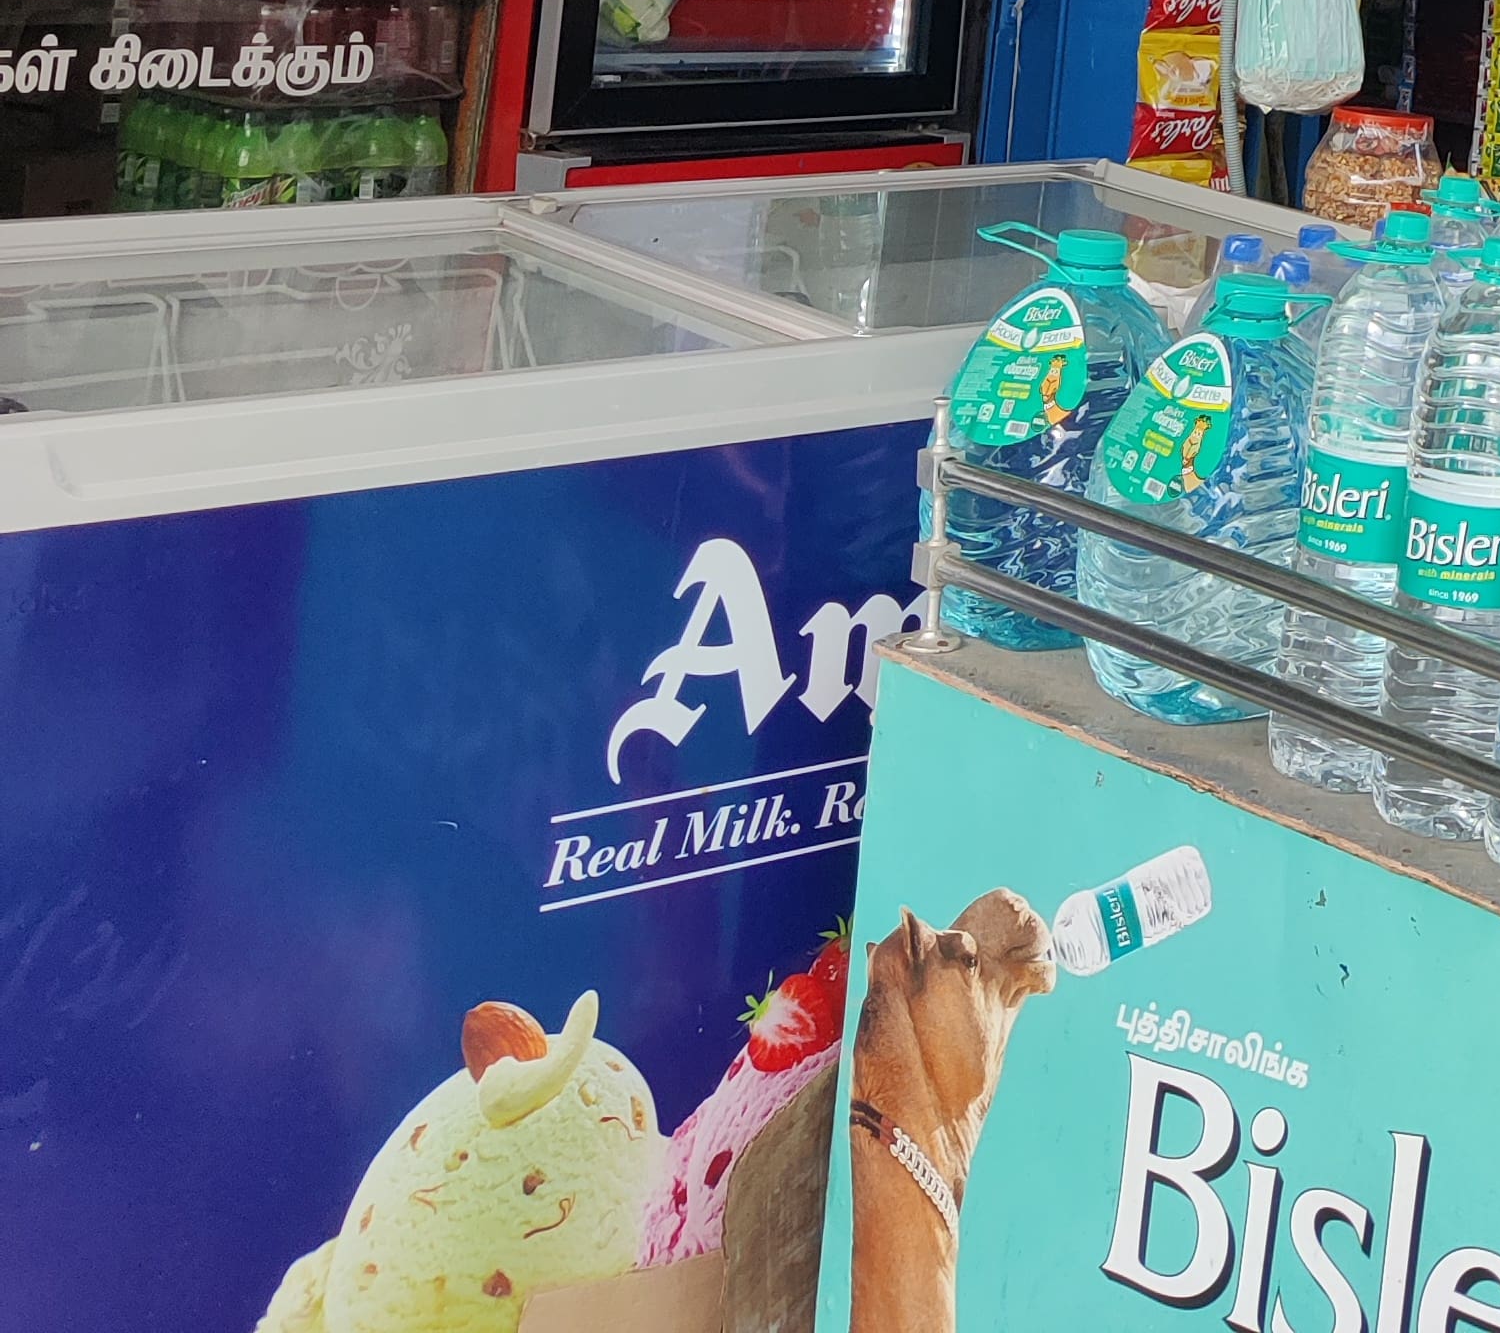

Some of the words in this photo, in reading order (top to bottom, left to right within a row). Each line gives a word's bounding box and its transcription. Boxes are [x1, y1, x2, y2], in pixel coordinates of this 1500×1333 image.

[89, 31, 374, 97] கிடைக்கும்
[1022, 305, 1064, 323] Bisleri
[1178, 349, 1219, 373] Bisleri
[1323, 539, 1348, 555] 1969
[1451, 590, 1480, 604] 1969
[542, 816, 669, 888] Real
[675, 794, 800, 860] Milk.
[1108, 886, 1132, 949] Bisleri
